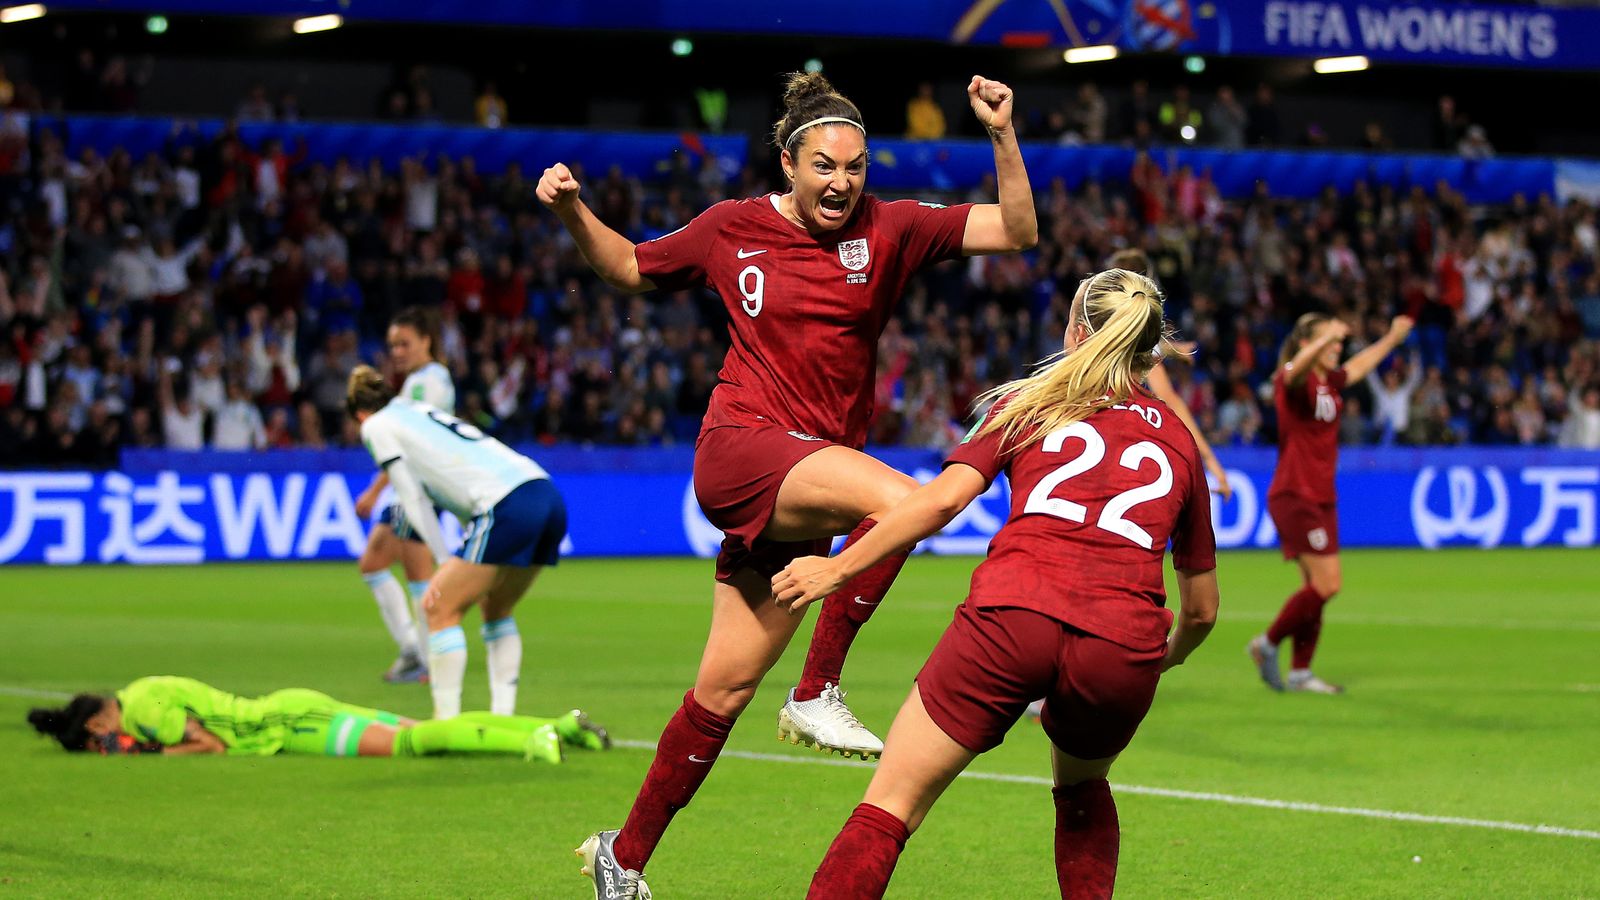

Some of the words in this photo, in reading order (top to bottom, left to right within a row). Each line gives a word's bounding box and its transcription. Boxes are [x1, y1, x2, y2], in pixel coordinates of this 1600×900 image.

[1264, 0, 1352, 48] FIFA
[1357, 6, 1557, 60] WOMEN'S
[738, 265, 765, 317] 9
[1315, 394, 1337, 423] 10
[1024, 421, 1173, 549] 22
[0, 471, 205, 564] 万达
[603, 870, 617, 899] asics
